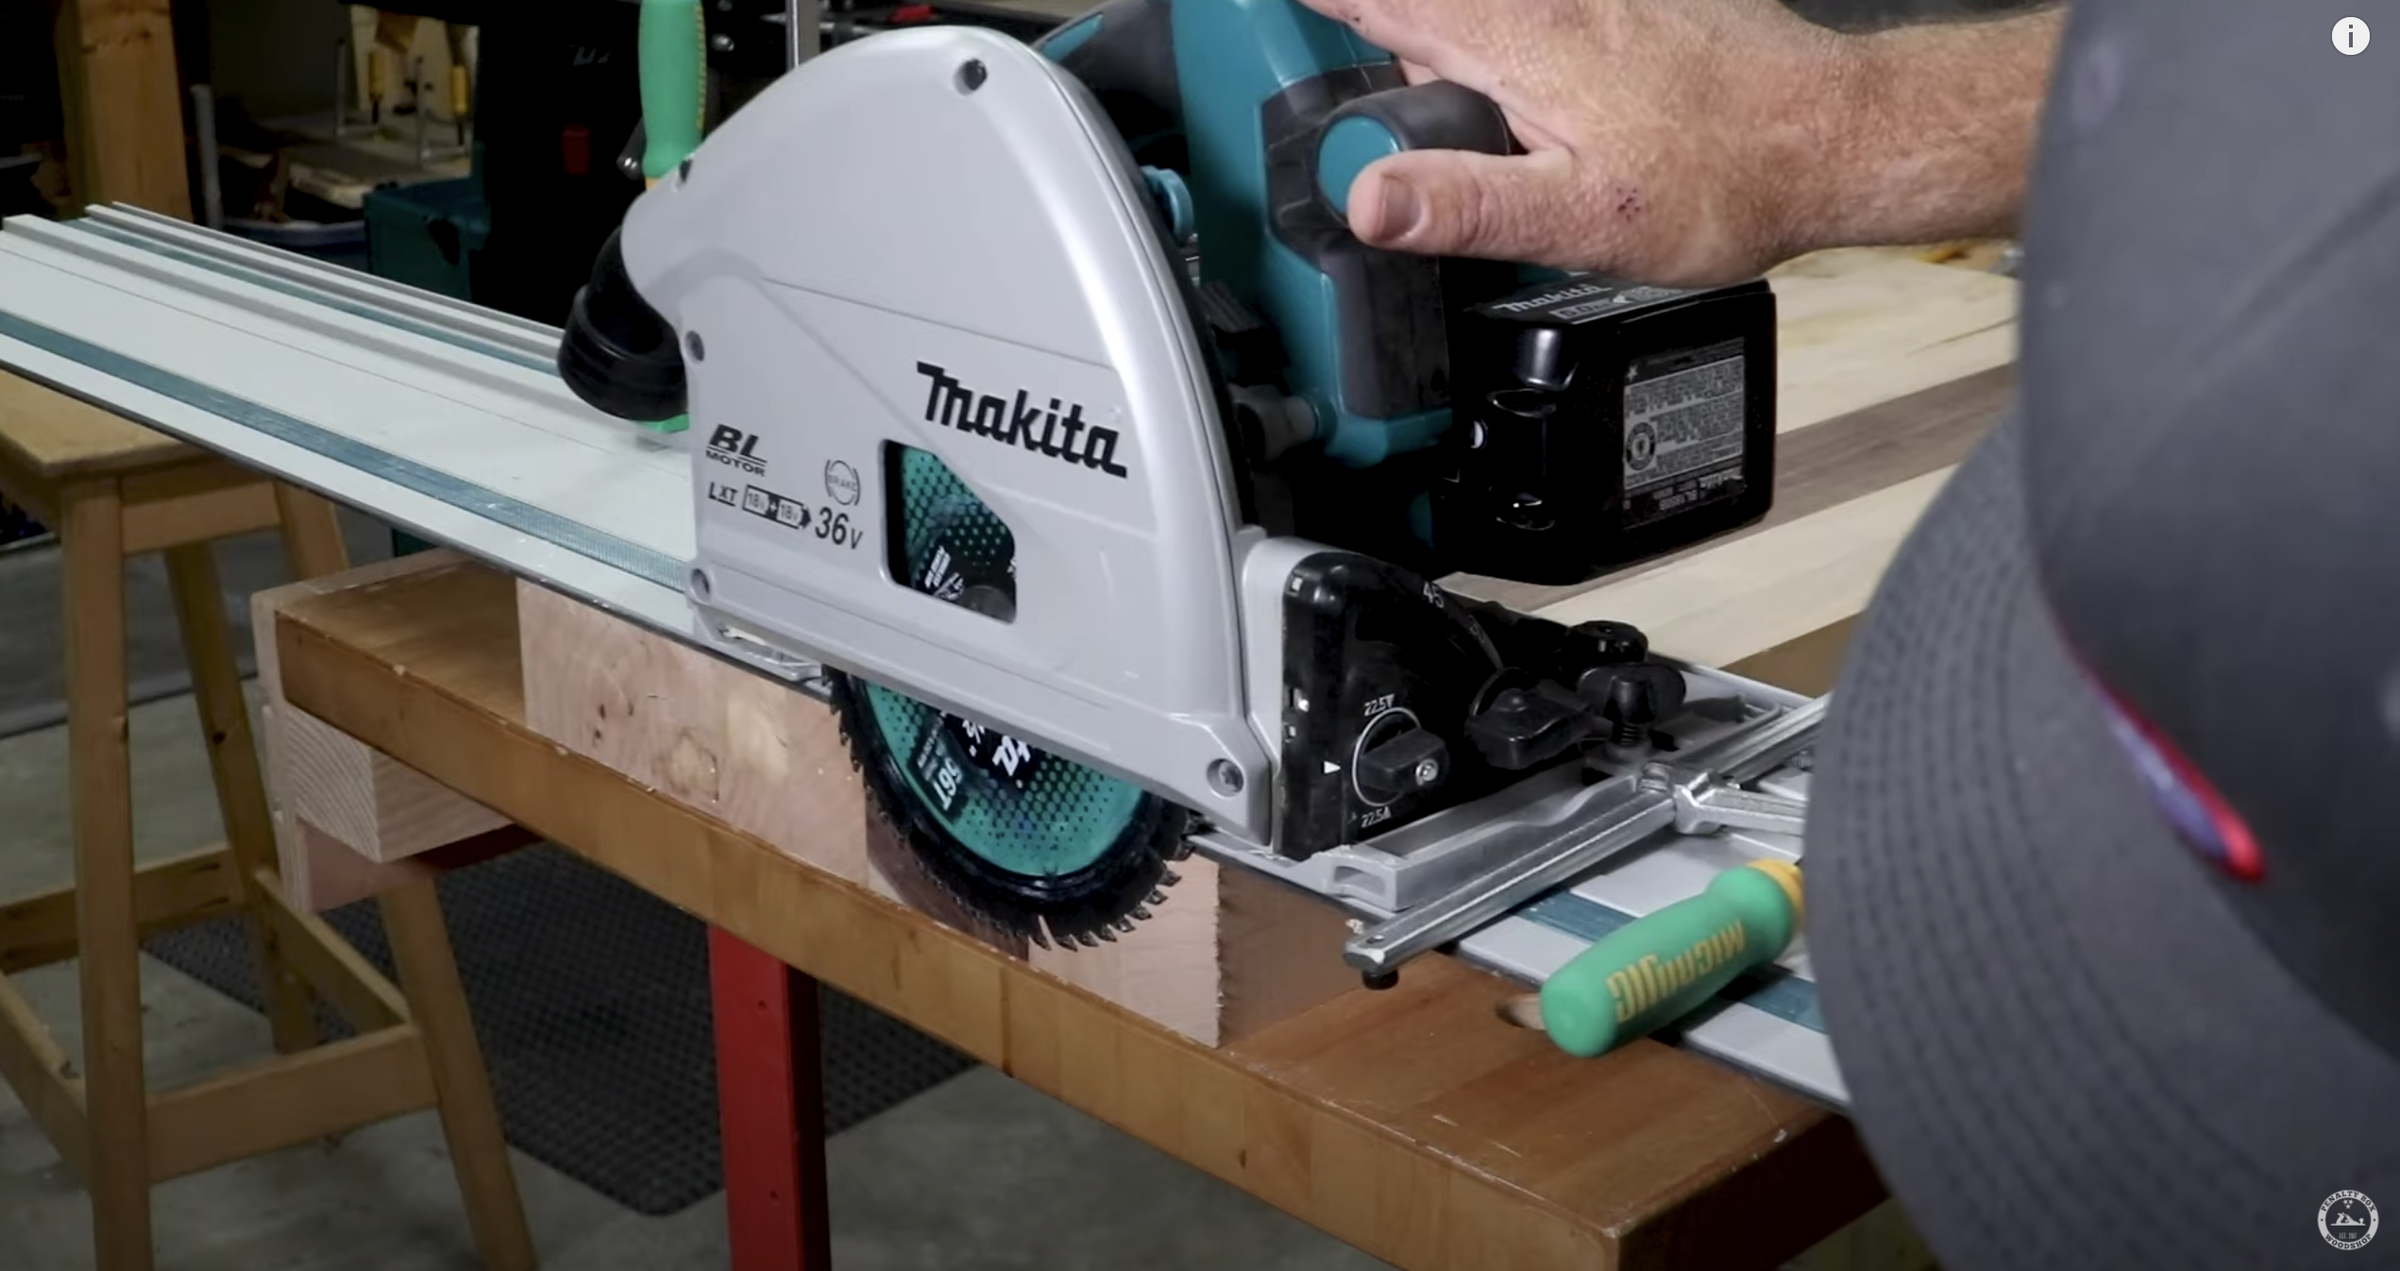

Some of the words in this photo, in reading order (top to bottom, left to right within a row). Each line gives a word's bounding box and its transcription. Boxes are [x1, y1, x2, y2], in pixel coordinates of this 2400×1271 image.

[917, 361, 1128, 479] Makita
[708, 424, 768, 463] BL
[706, 450, 766, 477] MOTOR
[708, 482, 739, 507] LXT
[1423, 582, 1445, 609] 45
